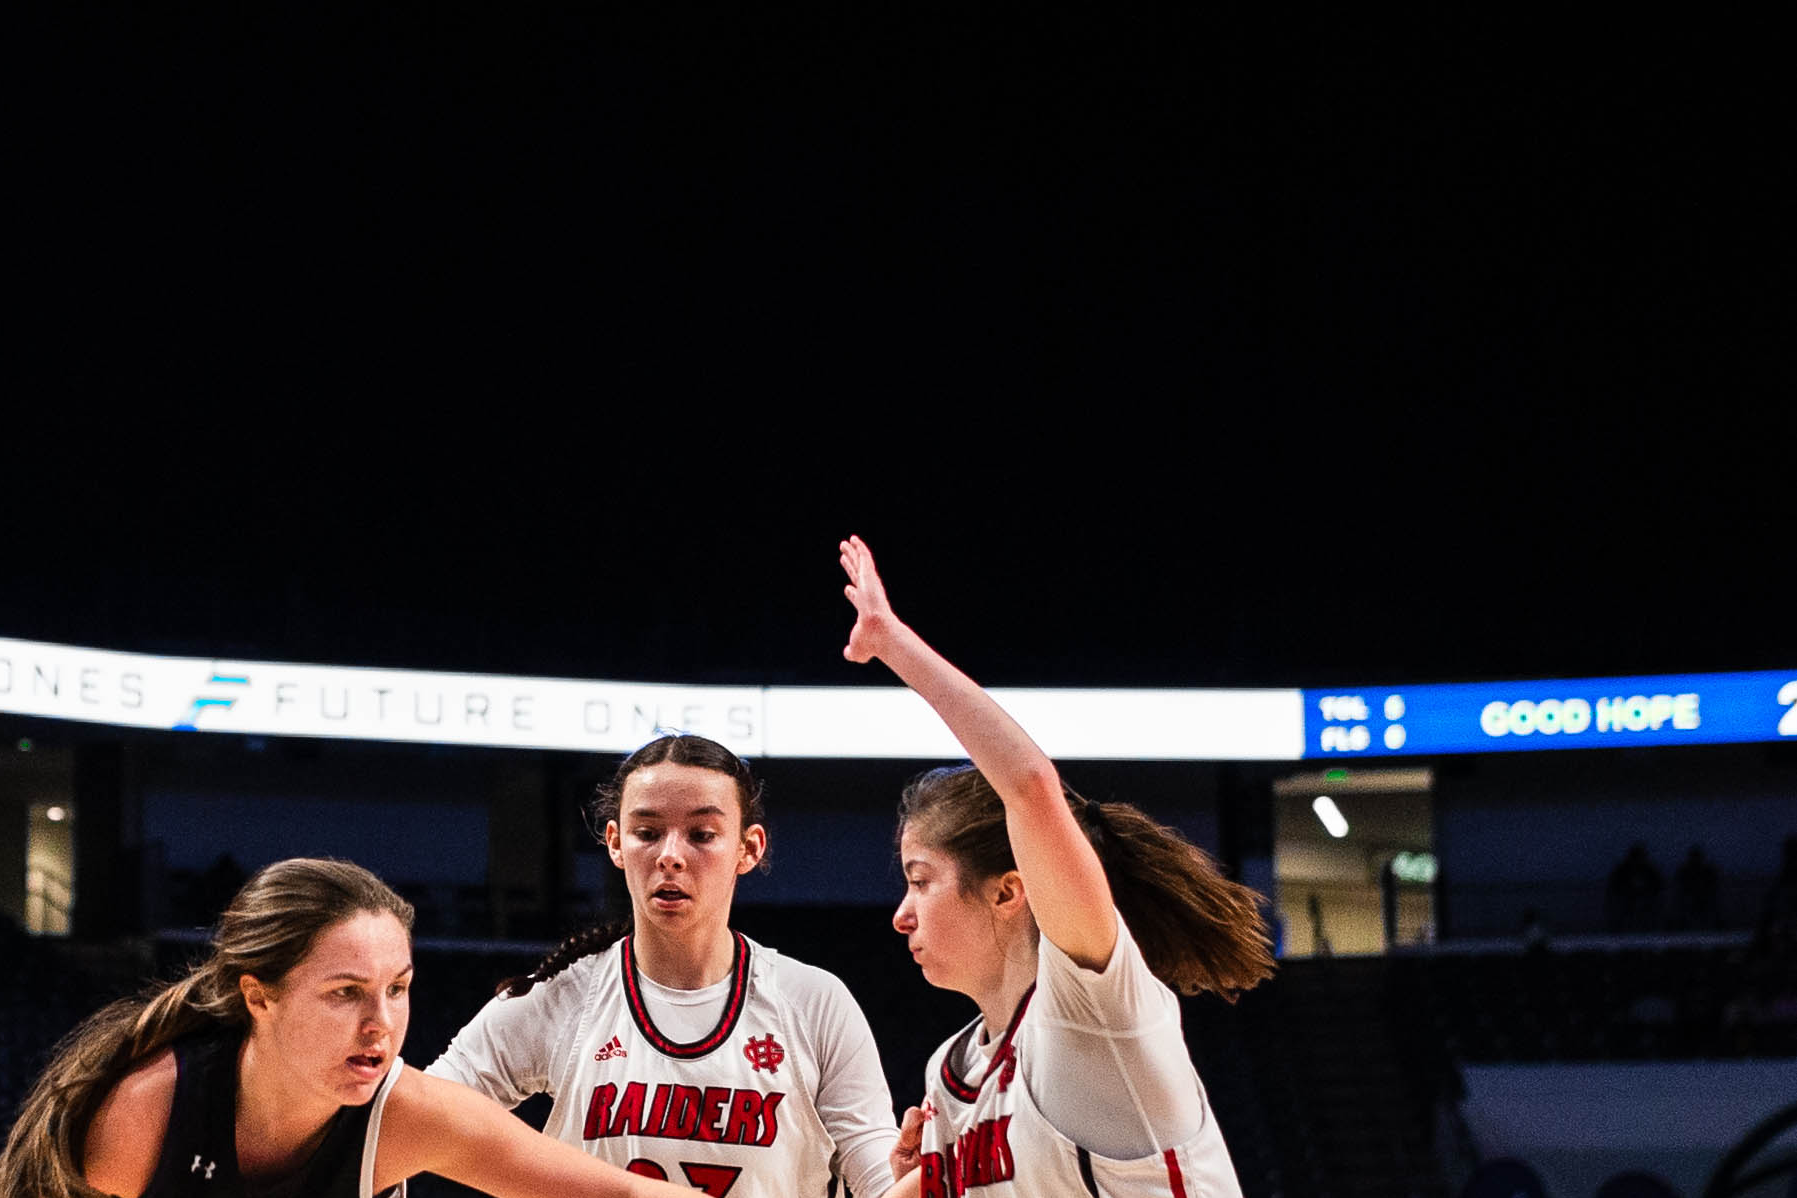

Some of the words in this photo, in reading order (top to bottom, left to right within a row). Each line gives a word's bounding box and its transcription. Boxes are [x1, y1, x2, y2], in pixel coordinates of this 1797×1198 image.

[273, 682, 537, 732] FUTURE
[582, 699, 754, 740] ONES
[1479, 698, 1591, 736] GOOD
[1596, 693, 1701, 734] HOPE
[583, 1081, 786, 1148] RAIDERS
